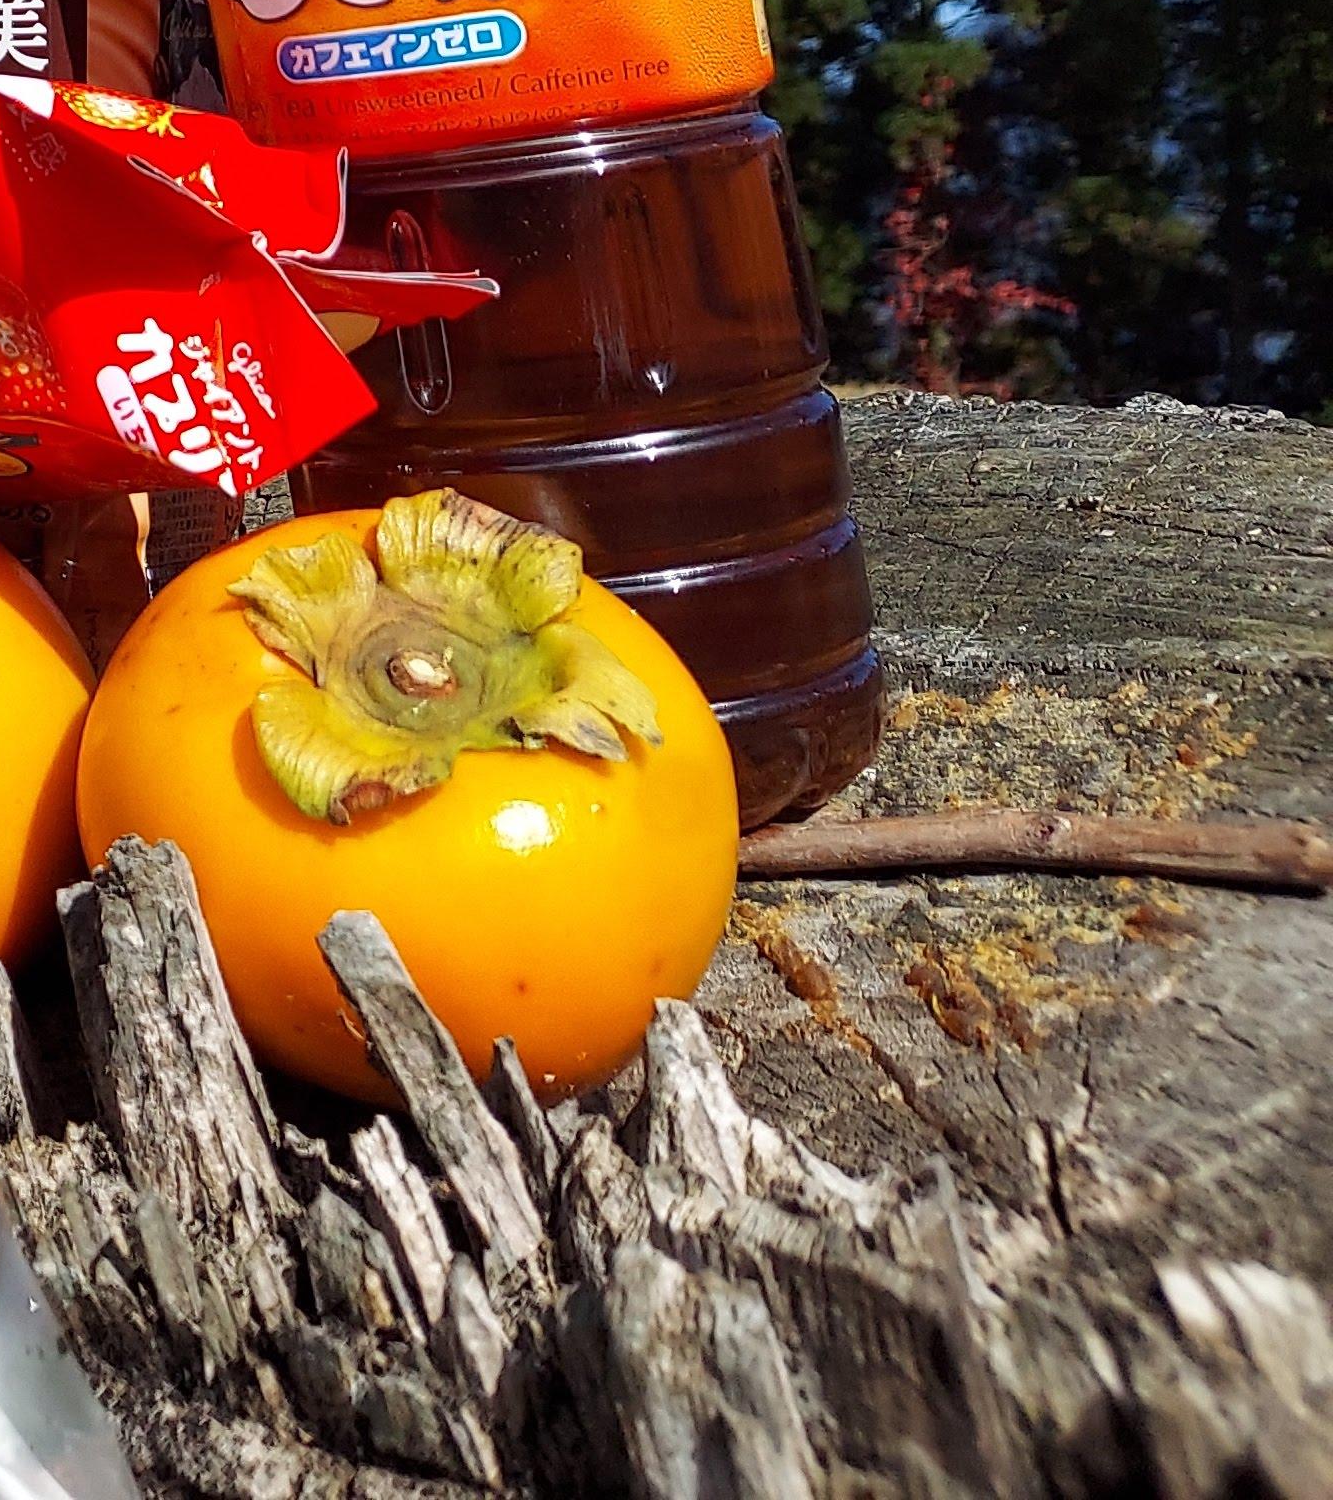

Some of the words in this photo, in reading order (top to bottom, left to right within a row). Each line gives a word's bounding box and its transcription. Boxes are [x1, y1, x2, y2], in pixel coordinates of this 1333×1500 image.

[289, 21, 504, 76] カフェインゼロ
[510, 67, 615, 96] Caffeine
[623, 55, 670, 81] Free
